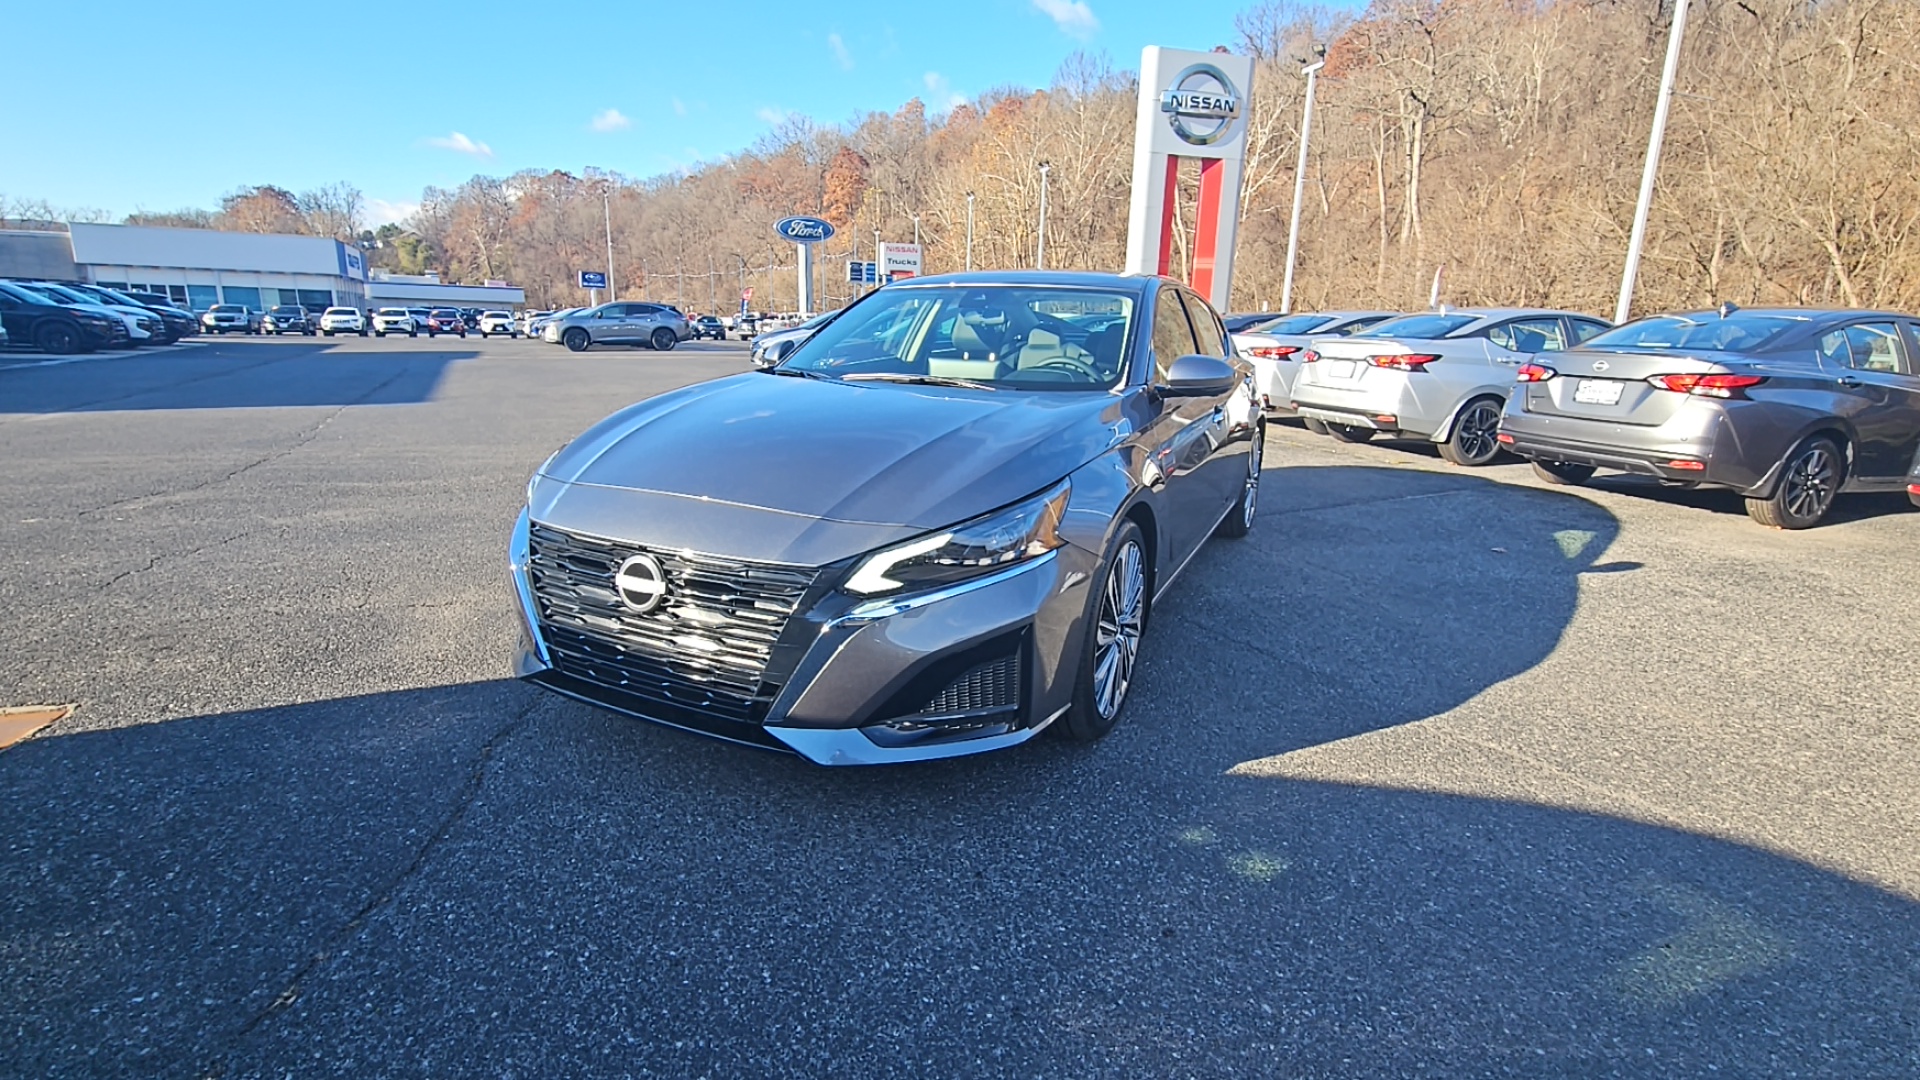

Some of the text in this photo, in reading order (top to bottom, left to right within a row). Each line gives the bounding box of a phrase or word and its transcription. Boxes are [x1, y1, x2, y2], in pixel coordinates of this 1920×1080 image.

[1170, 95, 1235, 112] NISSAN
[787, 220, 823, 237] Ford
[886, 246, 918, 254] NISSAN
